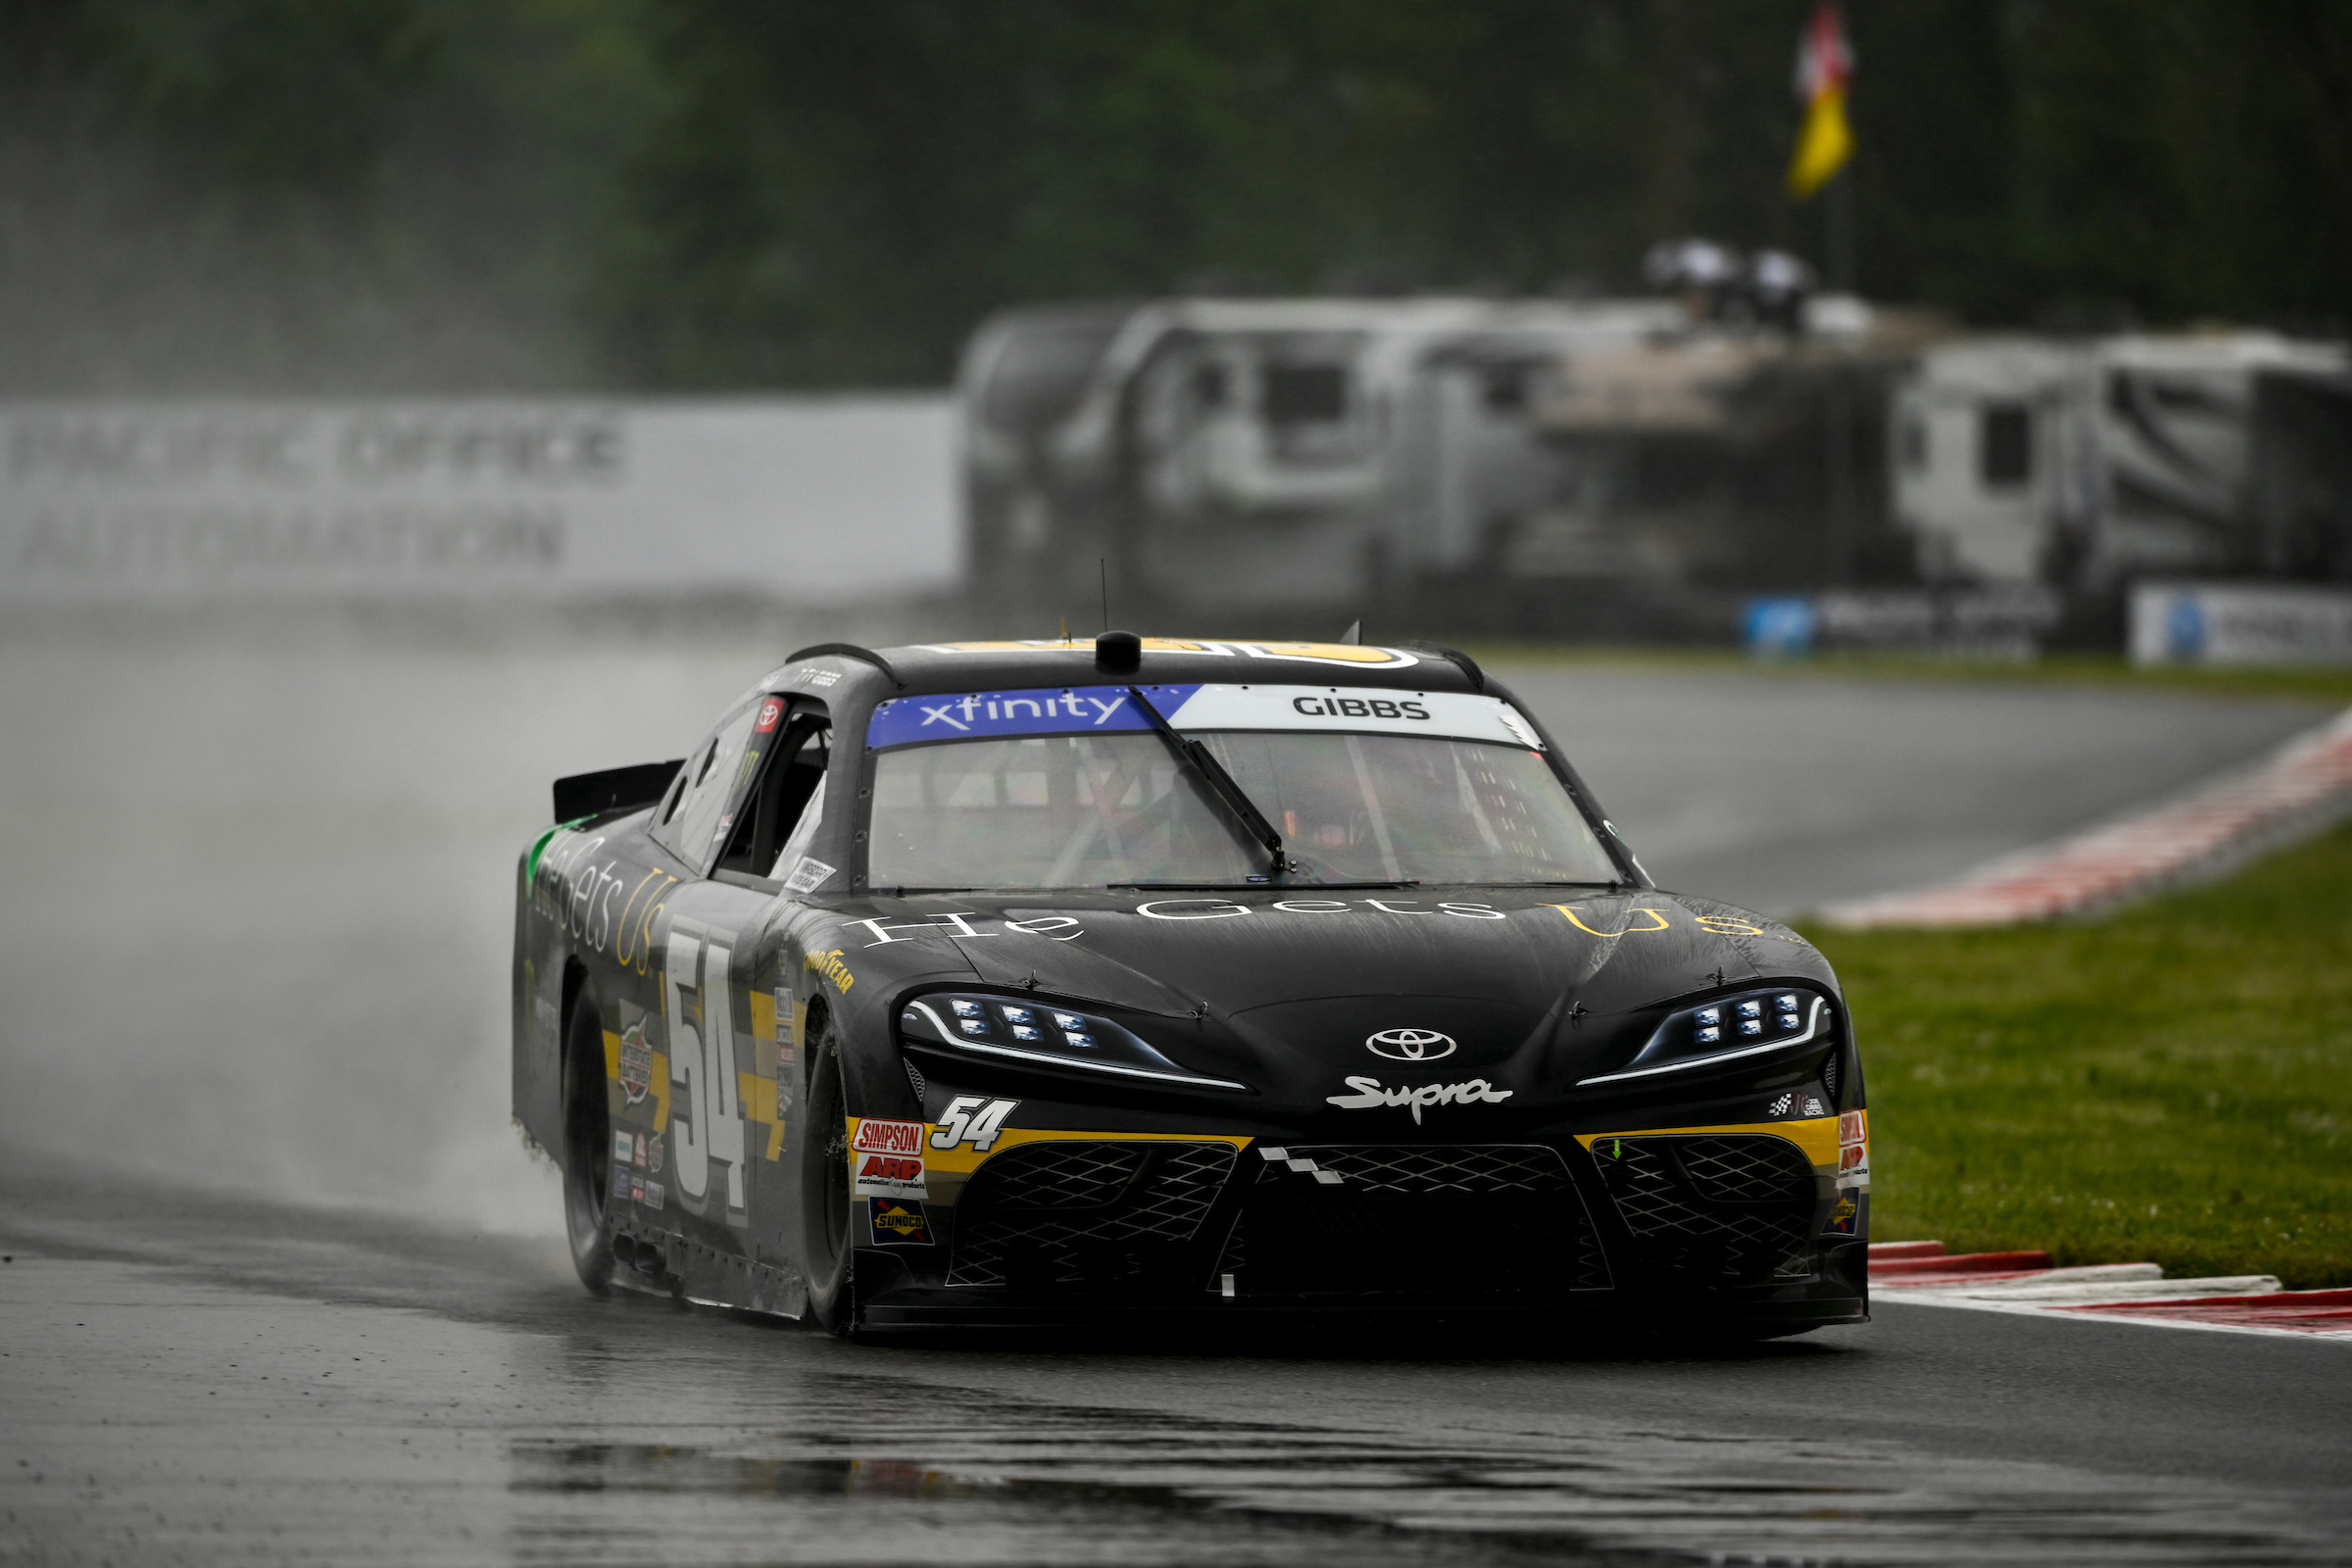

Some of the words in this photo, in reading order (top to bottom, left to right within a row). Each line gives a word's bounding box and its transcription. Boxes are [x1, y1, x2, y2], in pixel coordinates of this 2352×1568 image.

[919, 692, 1126, 731] xfinity
[1293, 697, 1431, 720] GIBBS
[617, 867, 677, 976] Us
[842, 912, 1085, 949] He
[1136, 899, 1506, 920] Gets
[1535, 903, 1764, 938] Us
[666, 928, 747, 1211] 54
[1326, 1076, 1513, 1126] Supra
[858, 1122, 919, 1152] SIMPSON
[931, 1095, 1020, 1152] 54
[859, 1155, 922, 1181] ARP
[878, 1214, 922, 1228] SUNOCO
